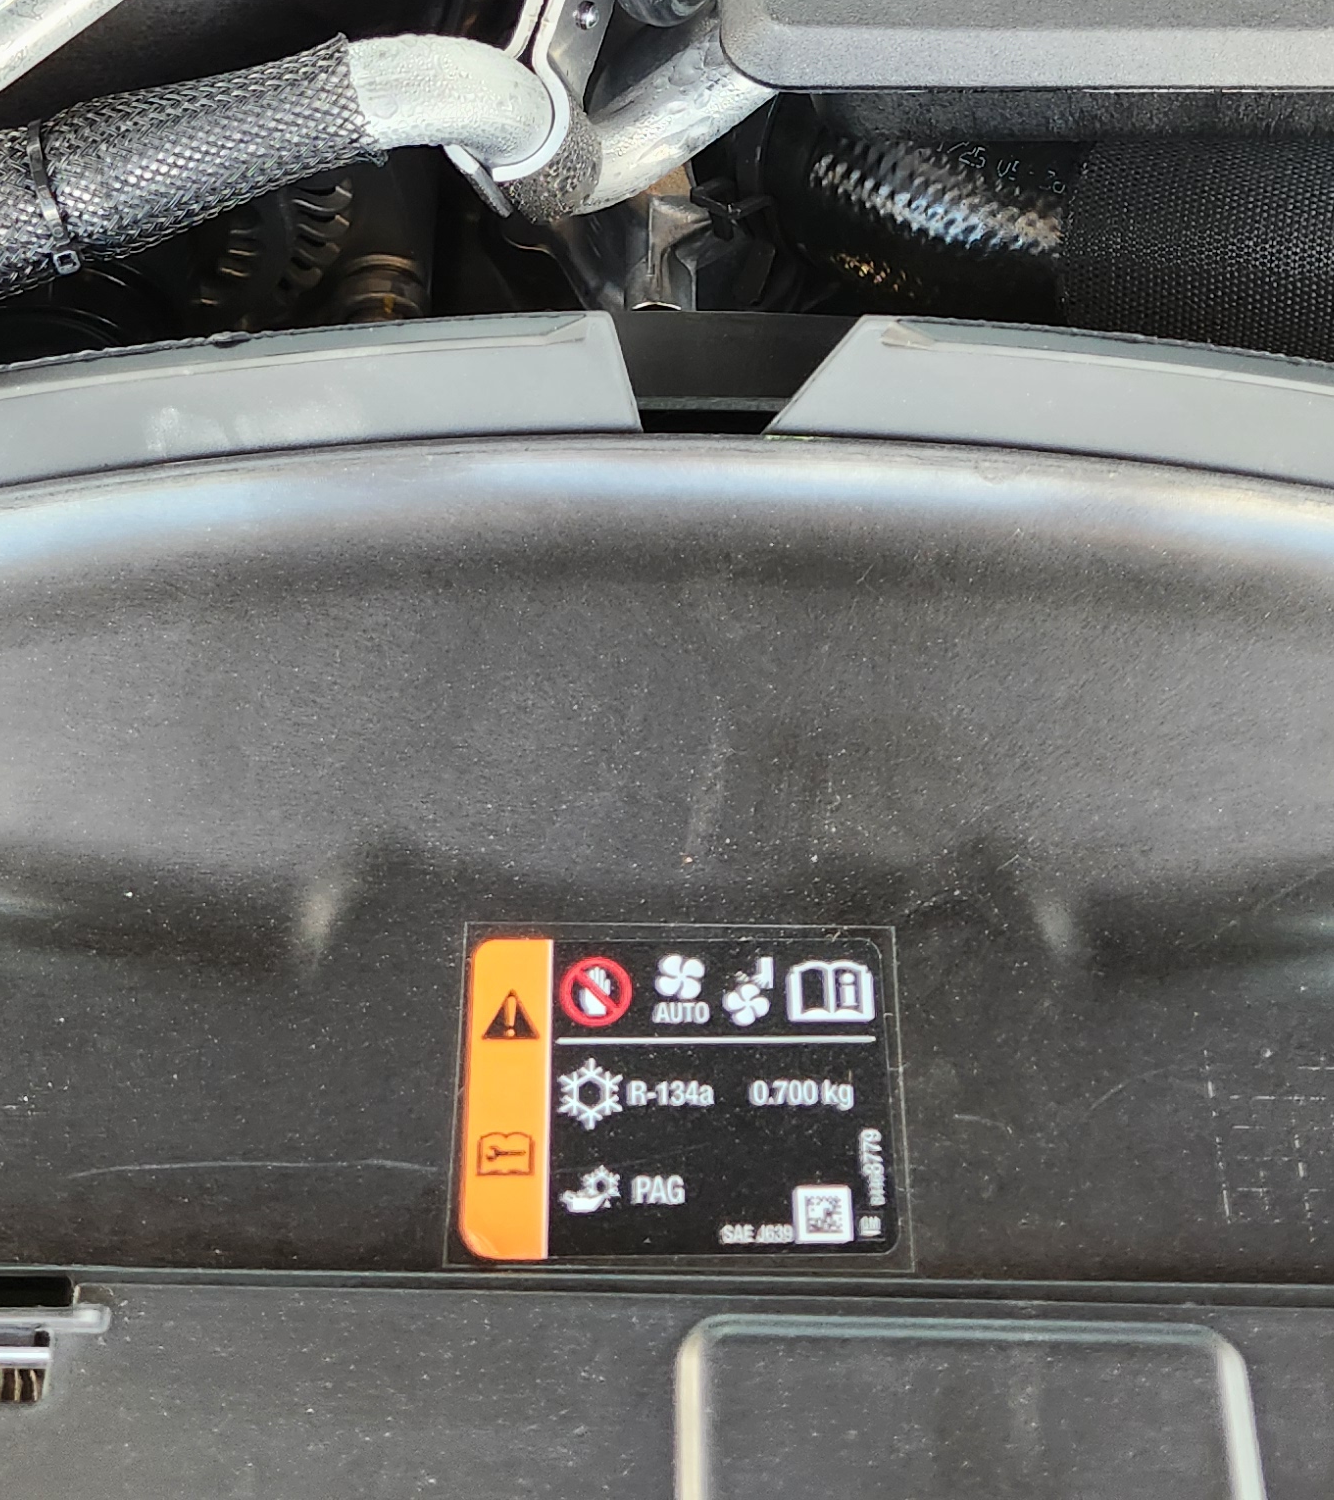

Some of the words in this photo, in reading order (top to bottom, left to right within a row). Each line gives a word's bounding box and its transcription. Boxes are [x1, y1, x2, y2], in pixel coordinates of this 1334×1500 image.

[652, 1001, 711, 1024] AUTO
[626, 1079, 715, 1107] R-134a
[748, 1079, 819, 1107] 0.700
[820, 1078, 855, 1112] kg
[631, 1174, 686, 1206] PAG
[720, 1223, 755, 1244] SAE
[755, 1223, 795, 1244] J639
